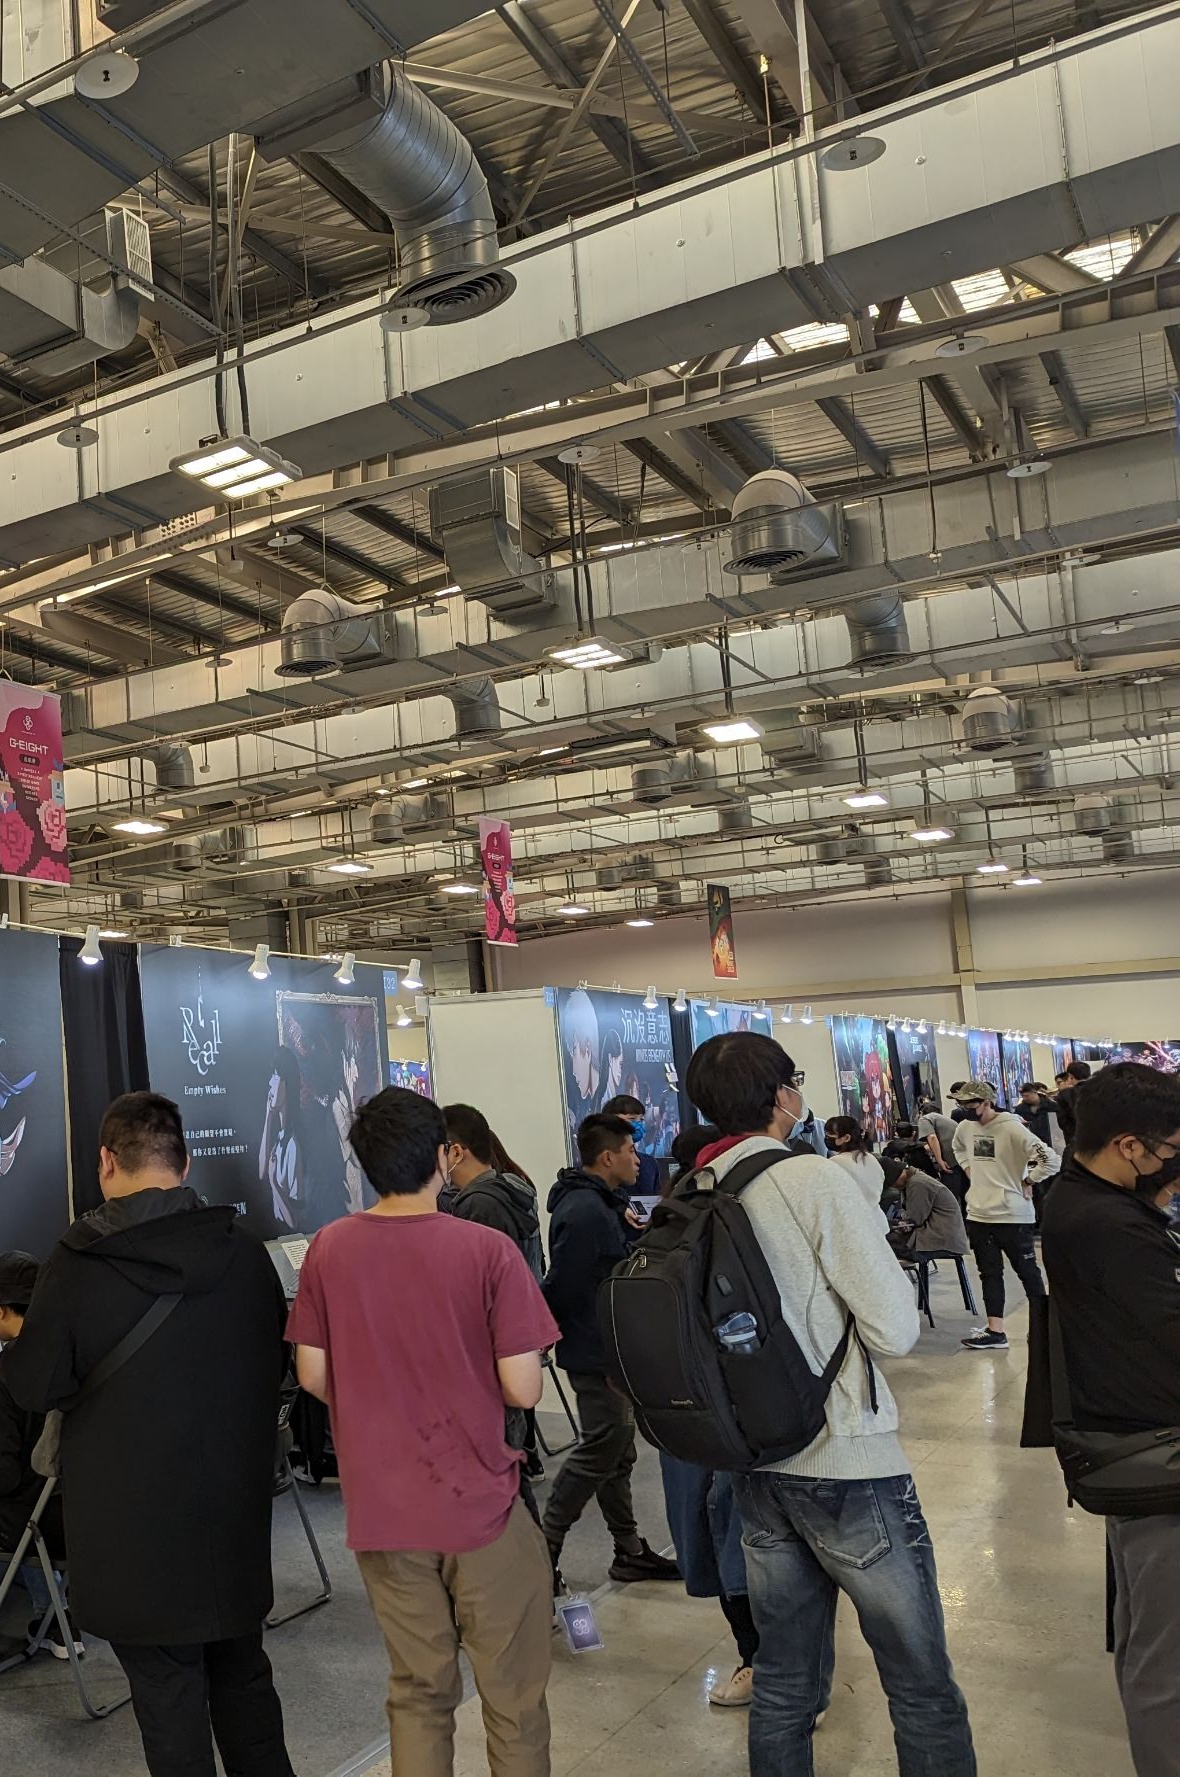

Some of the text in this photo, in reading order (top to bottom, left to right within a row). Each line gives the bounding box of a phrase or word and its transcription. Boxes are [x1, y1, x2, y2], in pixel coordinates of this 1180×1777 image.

[9, 738, 49, 756] G-EIGHT
[184, 1084, 226, 1096] Empty Wishes
